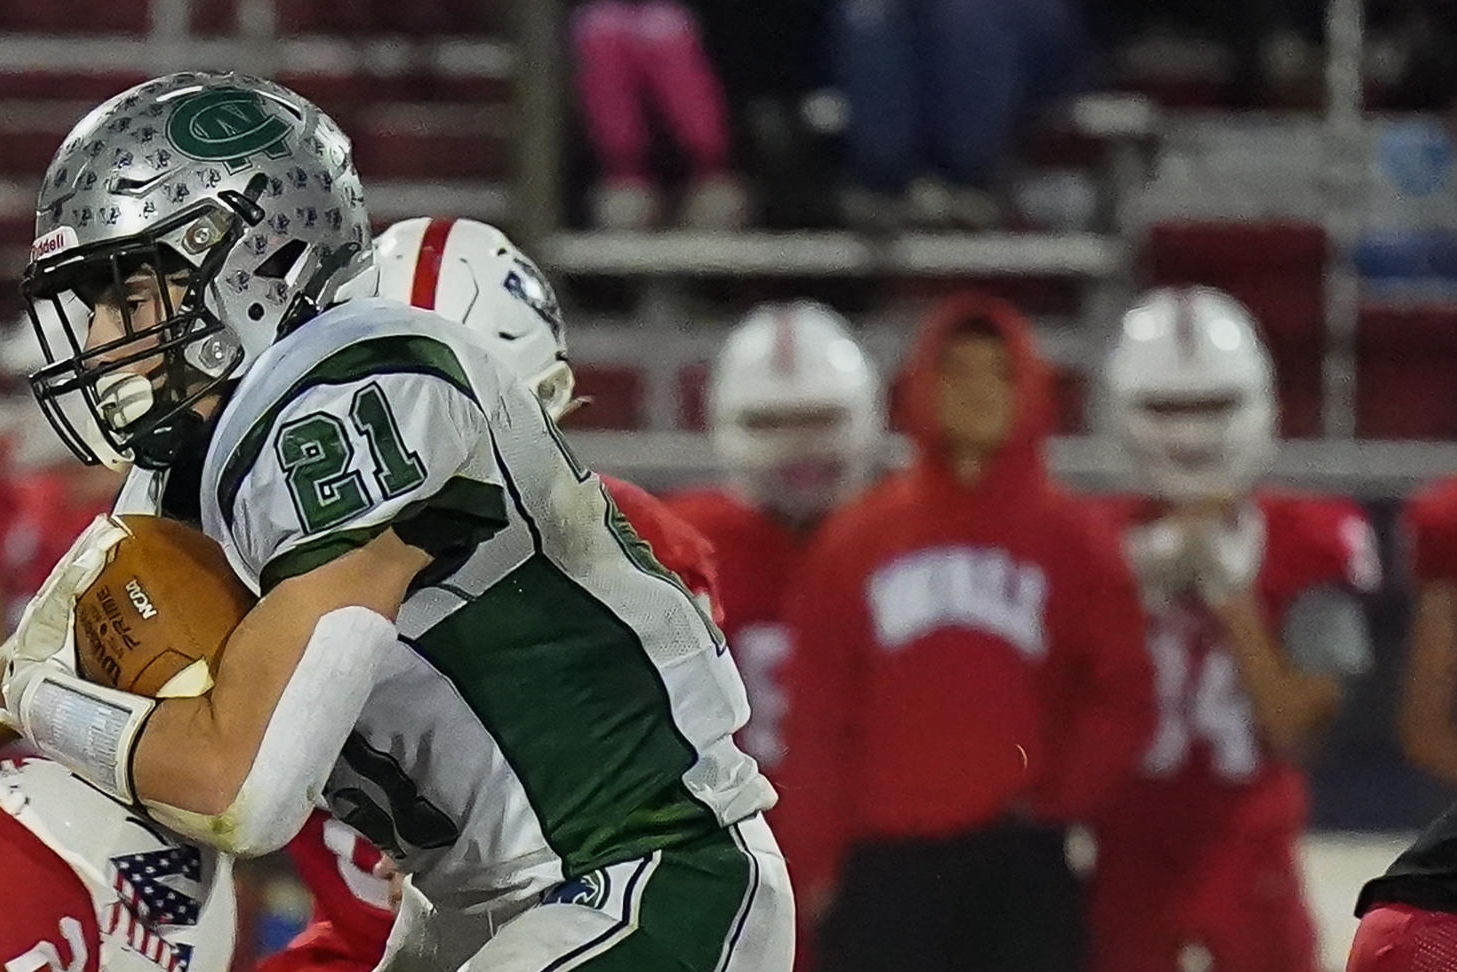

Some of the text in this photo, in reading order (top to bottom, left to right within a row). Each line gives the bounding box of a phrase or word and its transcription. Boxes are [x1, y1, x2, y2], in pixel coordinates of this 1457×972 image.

[273, 381, 428, 535] 21
[96, 584, 141, 651] PRIME
[125, 578, 158, 620] NCAA
